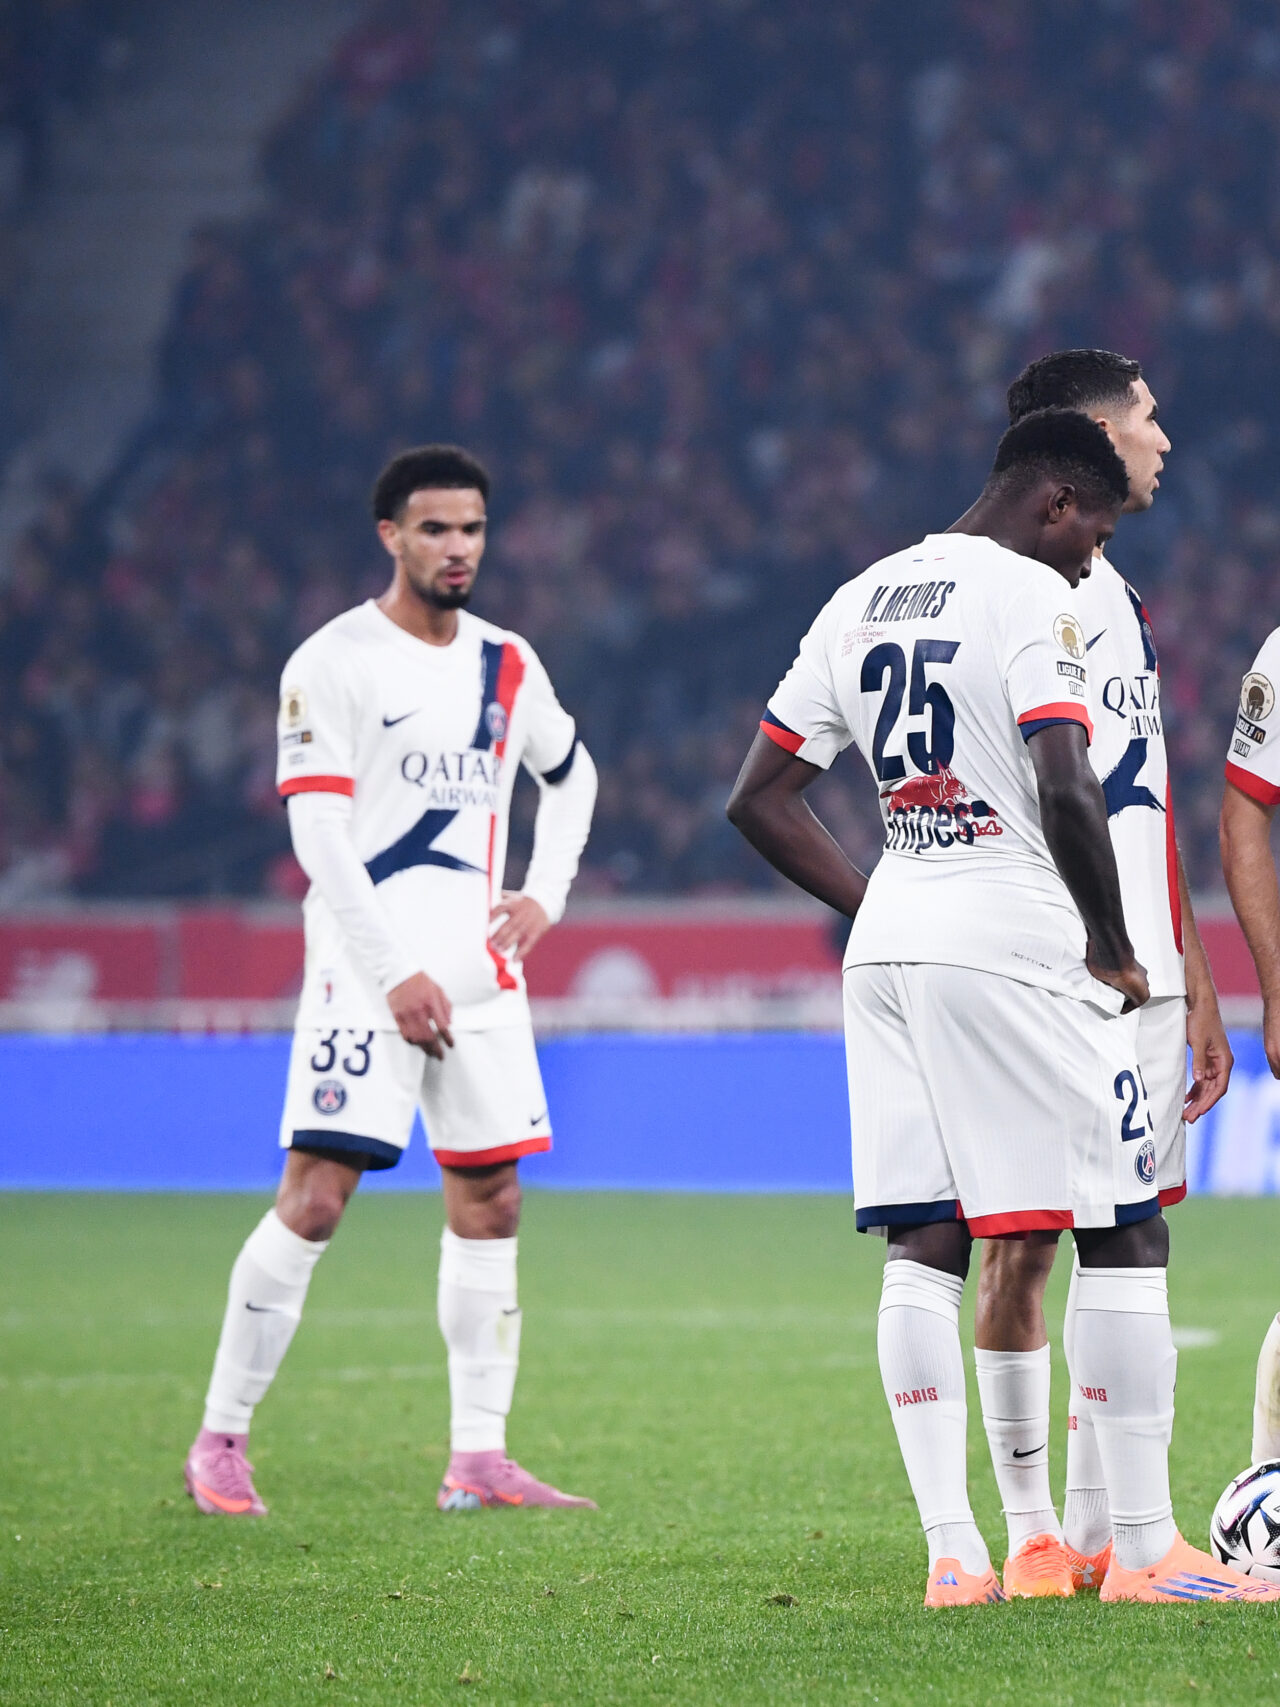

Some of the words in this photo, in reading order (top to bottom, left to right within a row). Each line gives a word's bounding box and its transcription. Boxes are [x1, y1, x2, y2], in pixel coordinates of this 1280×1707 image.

[861, 580, 956, 622] N.MENDES
[860, 638, 961, 781] 25
[310, 1029, 375, 1077] 33
[894, 1386, 939, 1408] PARIS
